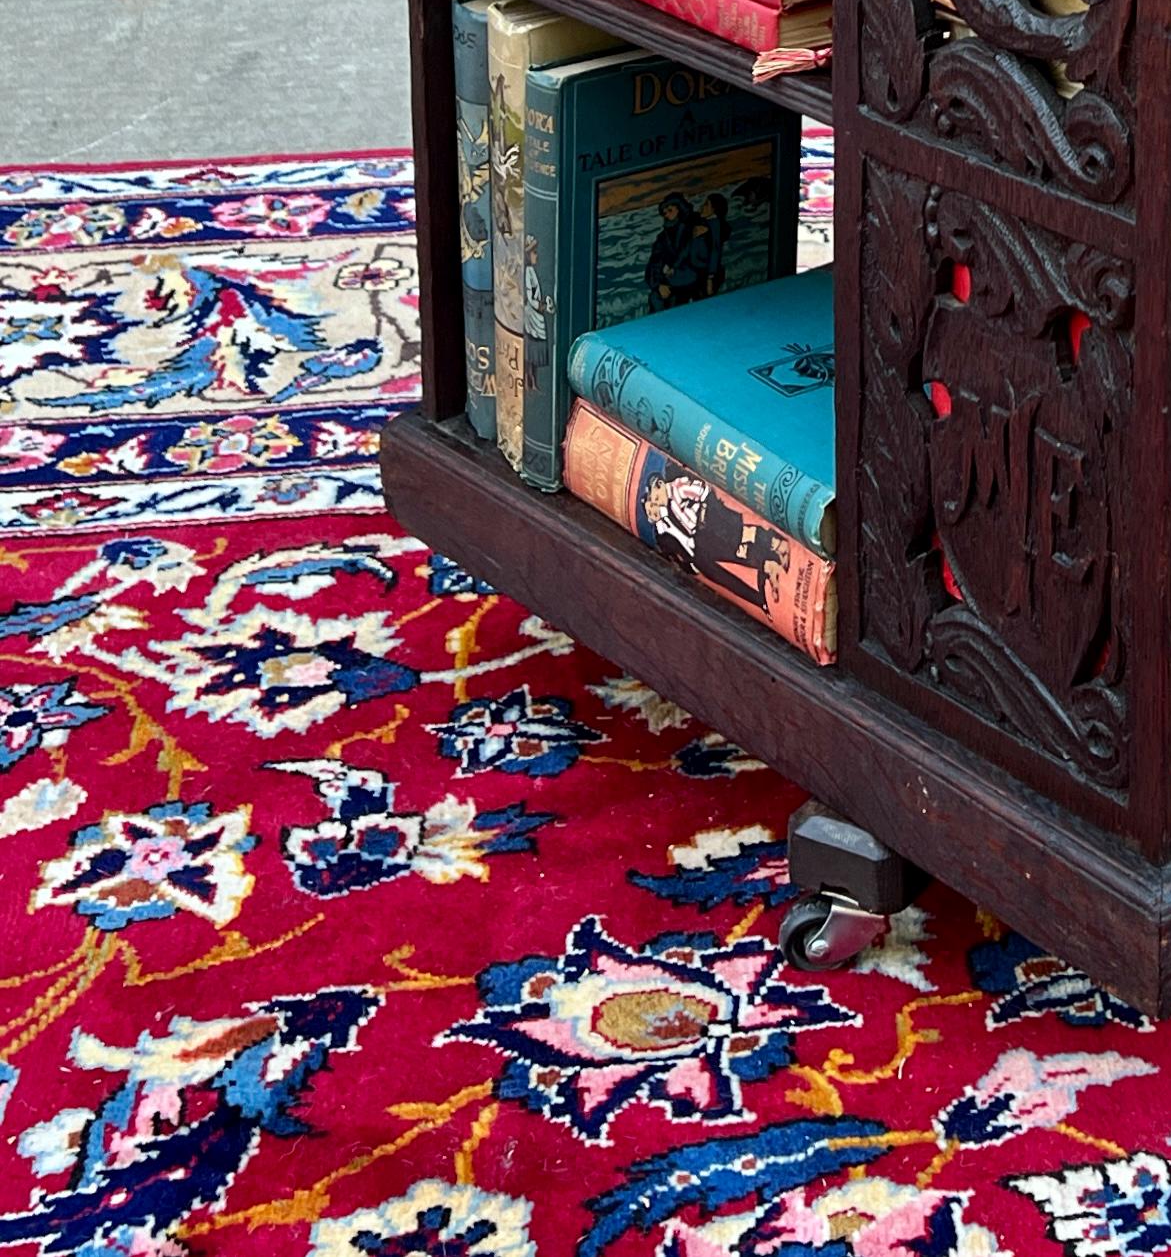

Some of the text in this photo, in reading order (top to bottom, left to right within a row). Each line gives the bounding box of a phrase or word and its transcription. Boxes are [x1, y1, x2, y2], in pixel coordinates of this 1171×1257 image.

[632, 69, 738, 116] DOR
[526, 109, 555, 134] ORA
[578, 143, 633, 172] TALE
[639, 134, 668, 157] OF
